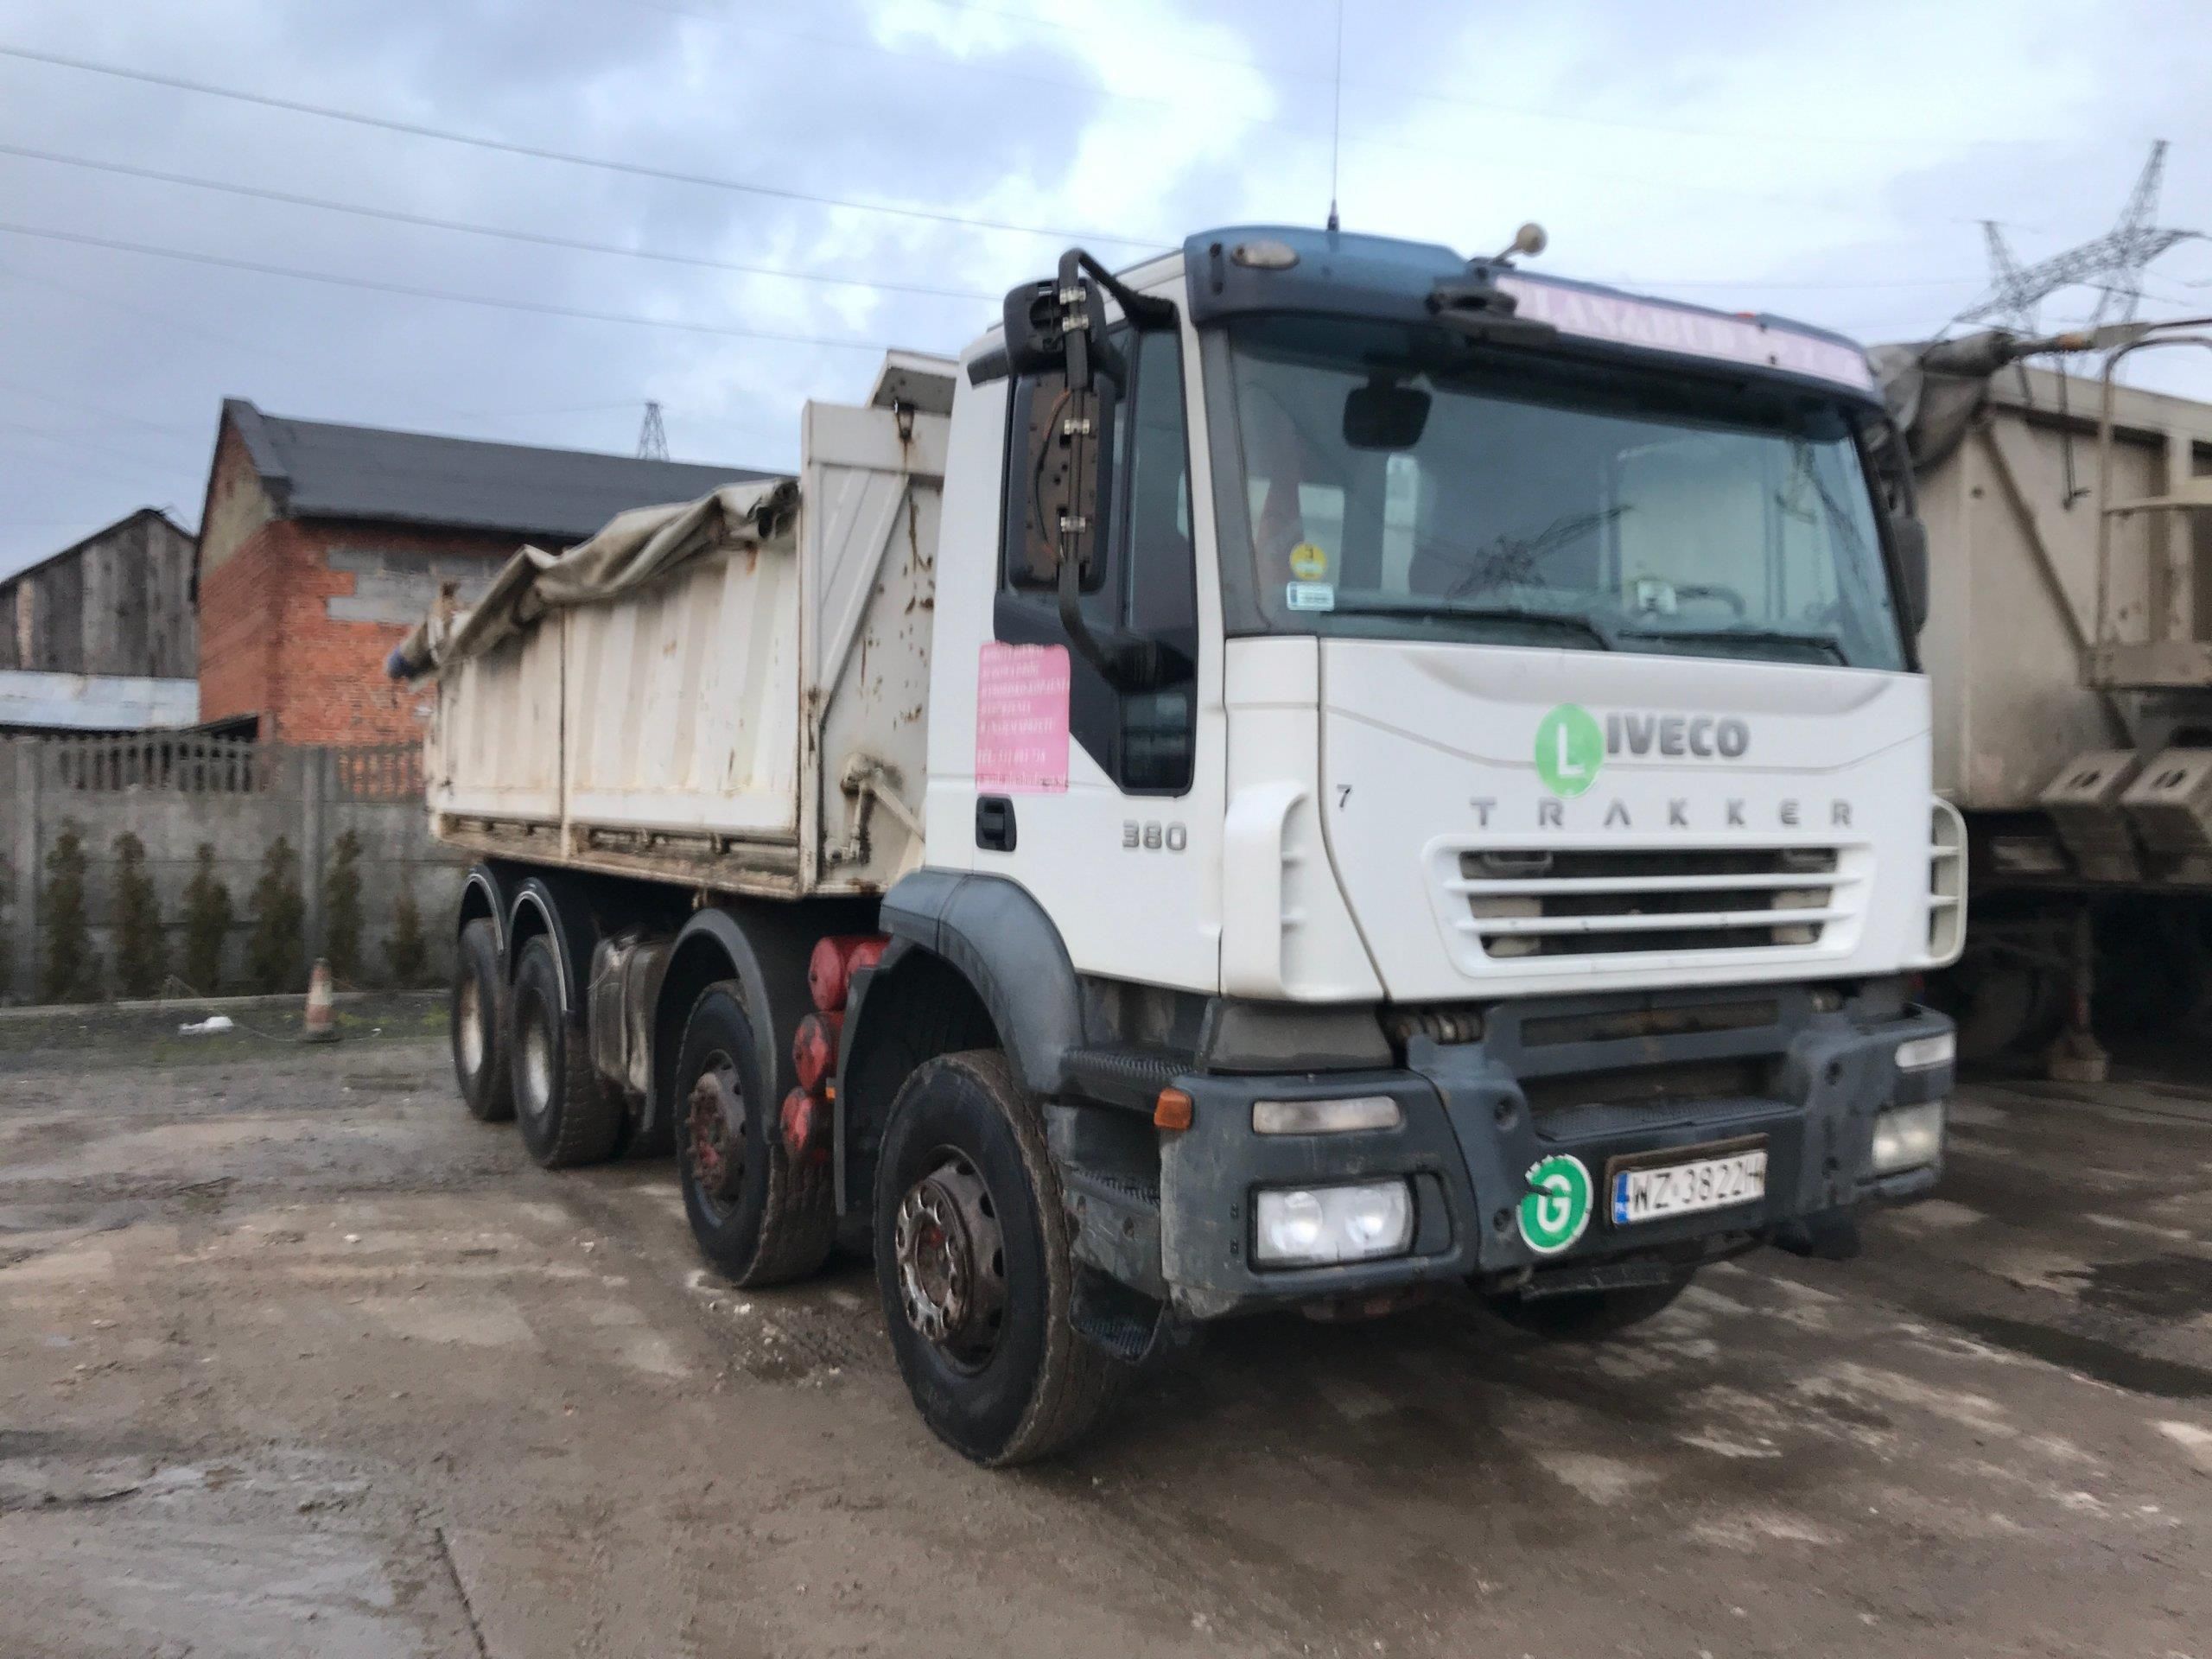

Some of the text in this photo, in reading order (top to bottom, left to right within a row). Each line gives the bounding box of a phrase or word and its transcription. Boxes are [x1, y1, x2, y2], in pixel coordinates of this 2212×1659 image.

[1557, 722, 1586, 776] L
[1606, 714, 1751, 758] IVECO
[1338, 785, 1352, 809] 7
[1470, 797, 1853, 826] TRAKKER
[1122, 821, 1186, 850] 380
[1536, 1173, 1572, 1233] G
